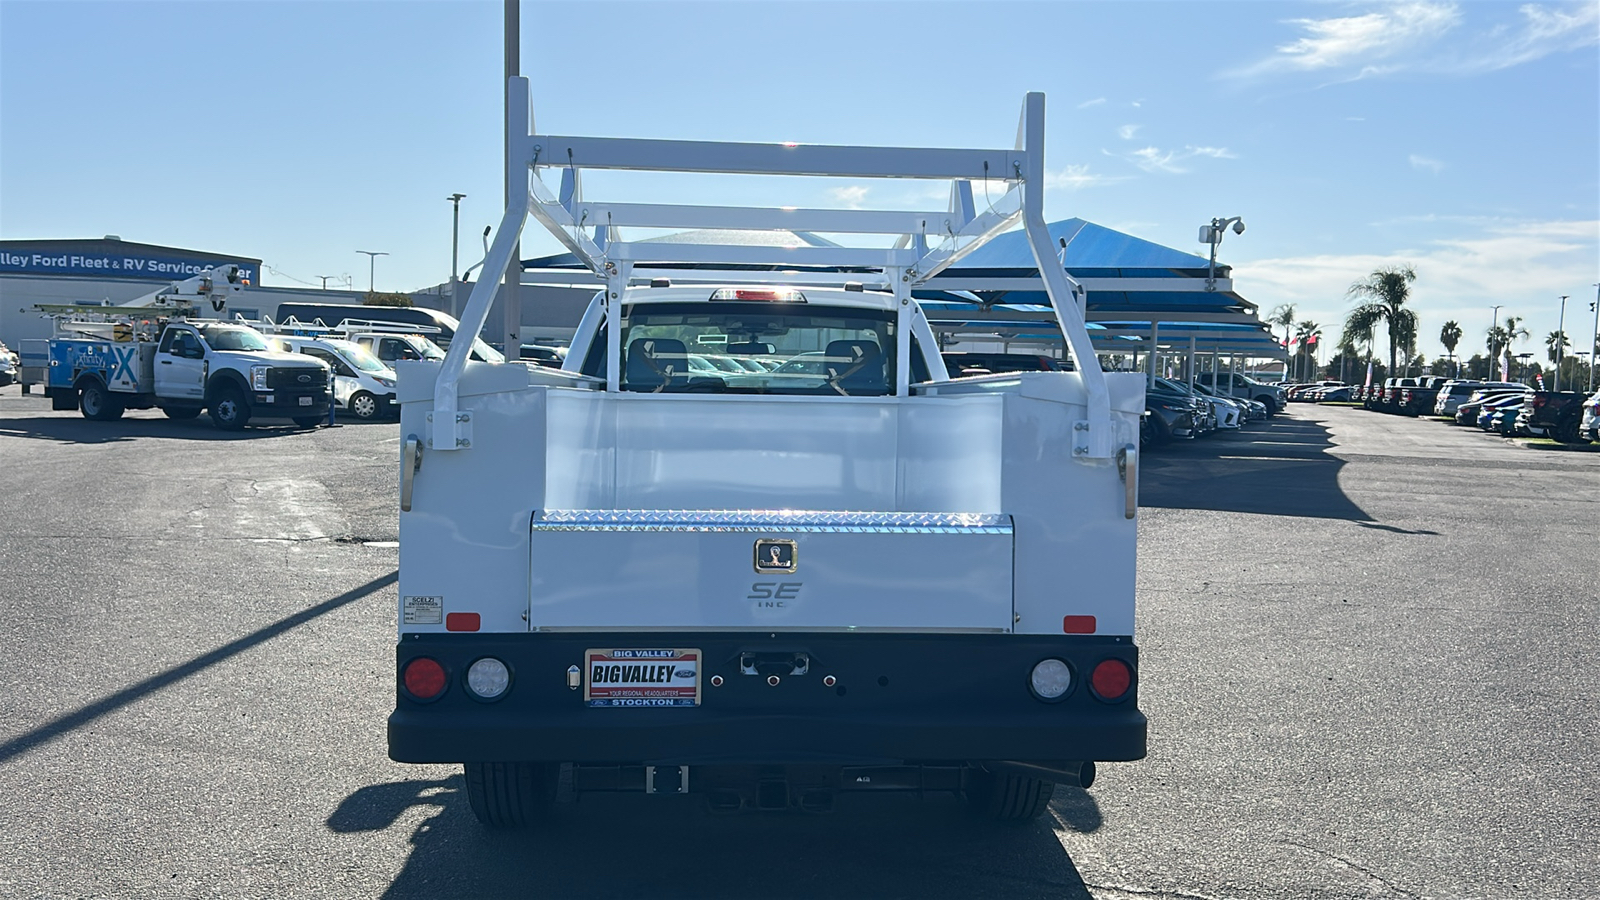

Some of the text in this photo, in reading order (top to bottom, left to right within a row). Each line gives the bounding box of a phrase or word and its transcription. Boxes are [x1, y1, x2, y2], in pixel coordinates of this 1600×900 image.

[0, 253, 28, 267] lley
[32, 254, 67, 267] Ford
[71, 256, 109, 269] Fleet
[112, 260, 120, 269] &
[123, 258, 145, 270] RV
[147, 260, 201, 275] Service
[747, 582, 803, 599] SE
